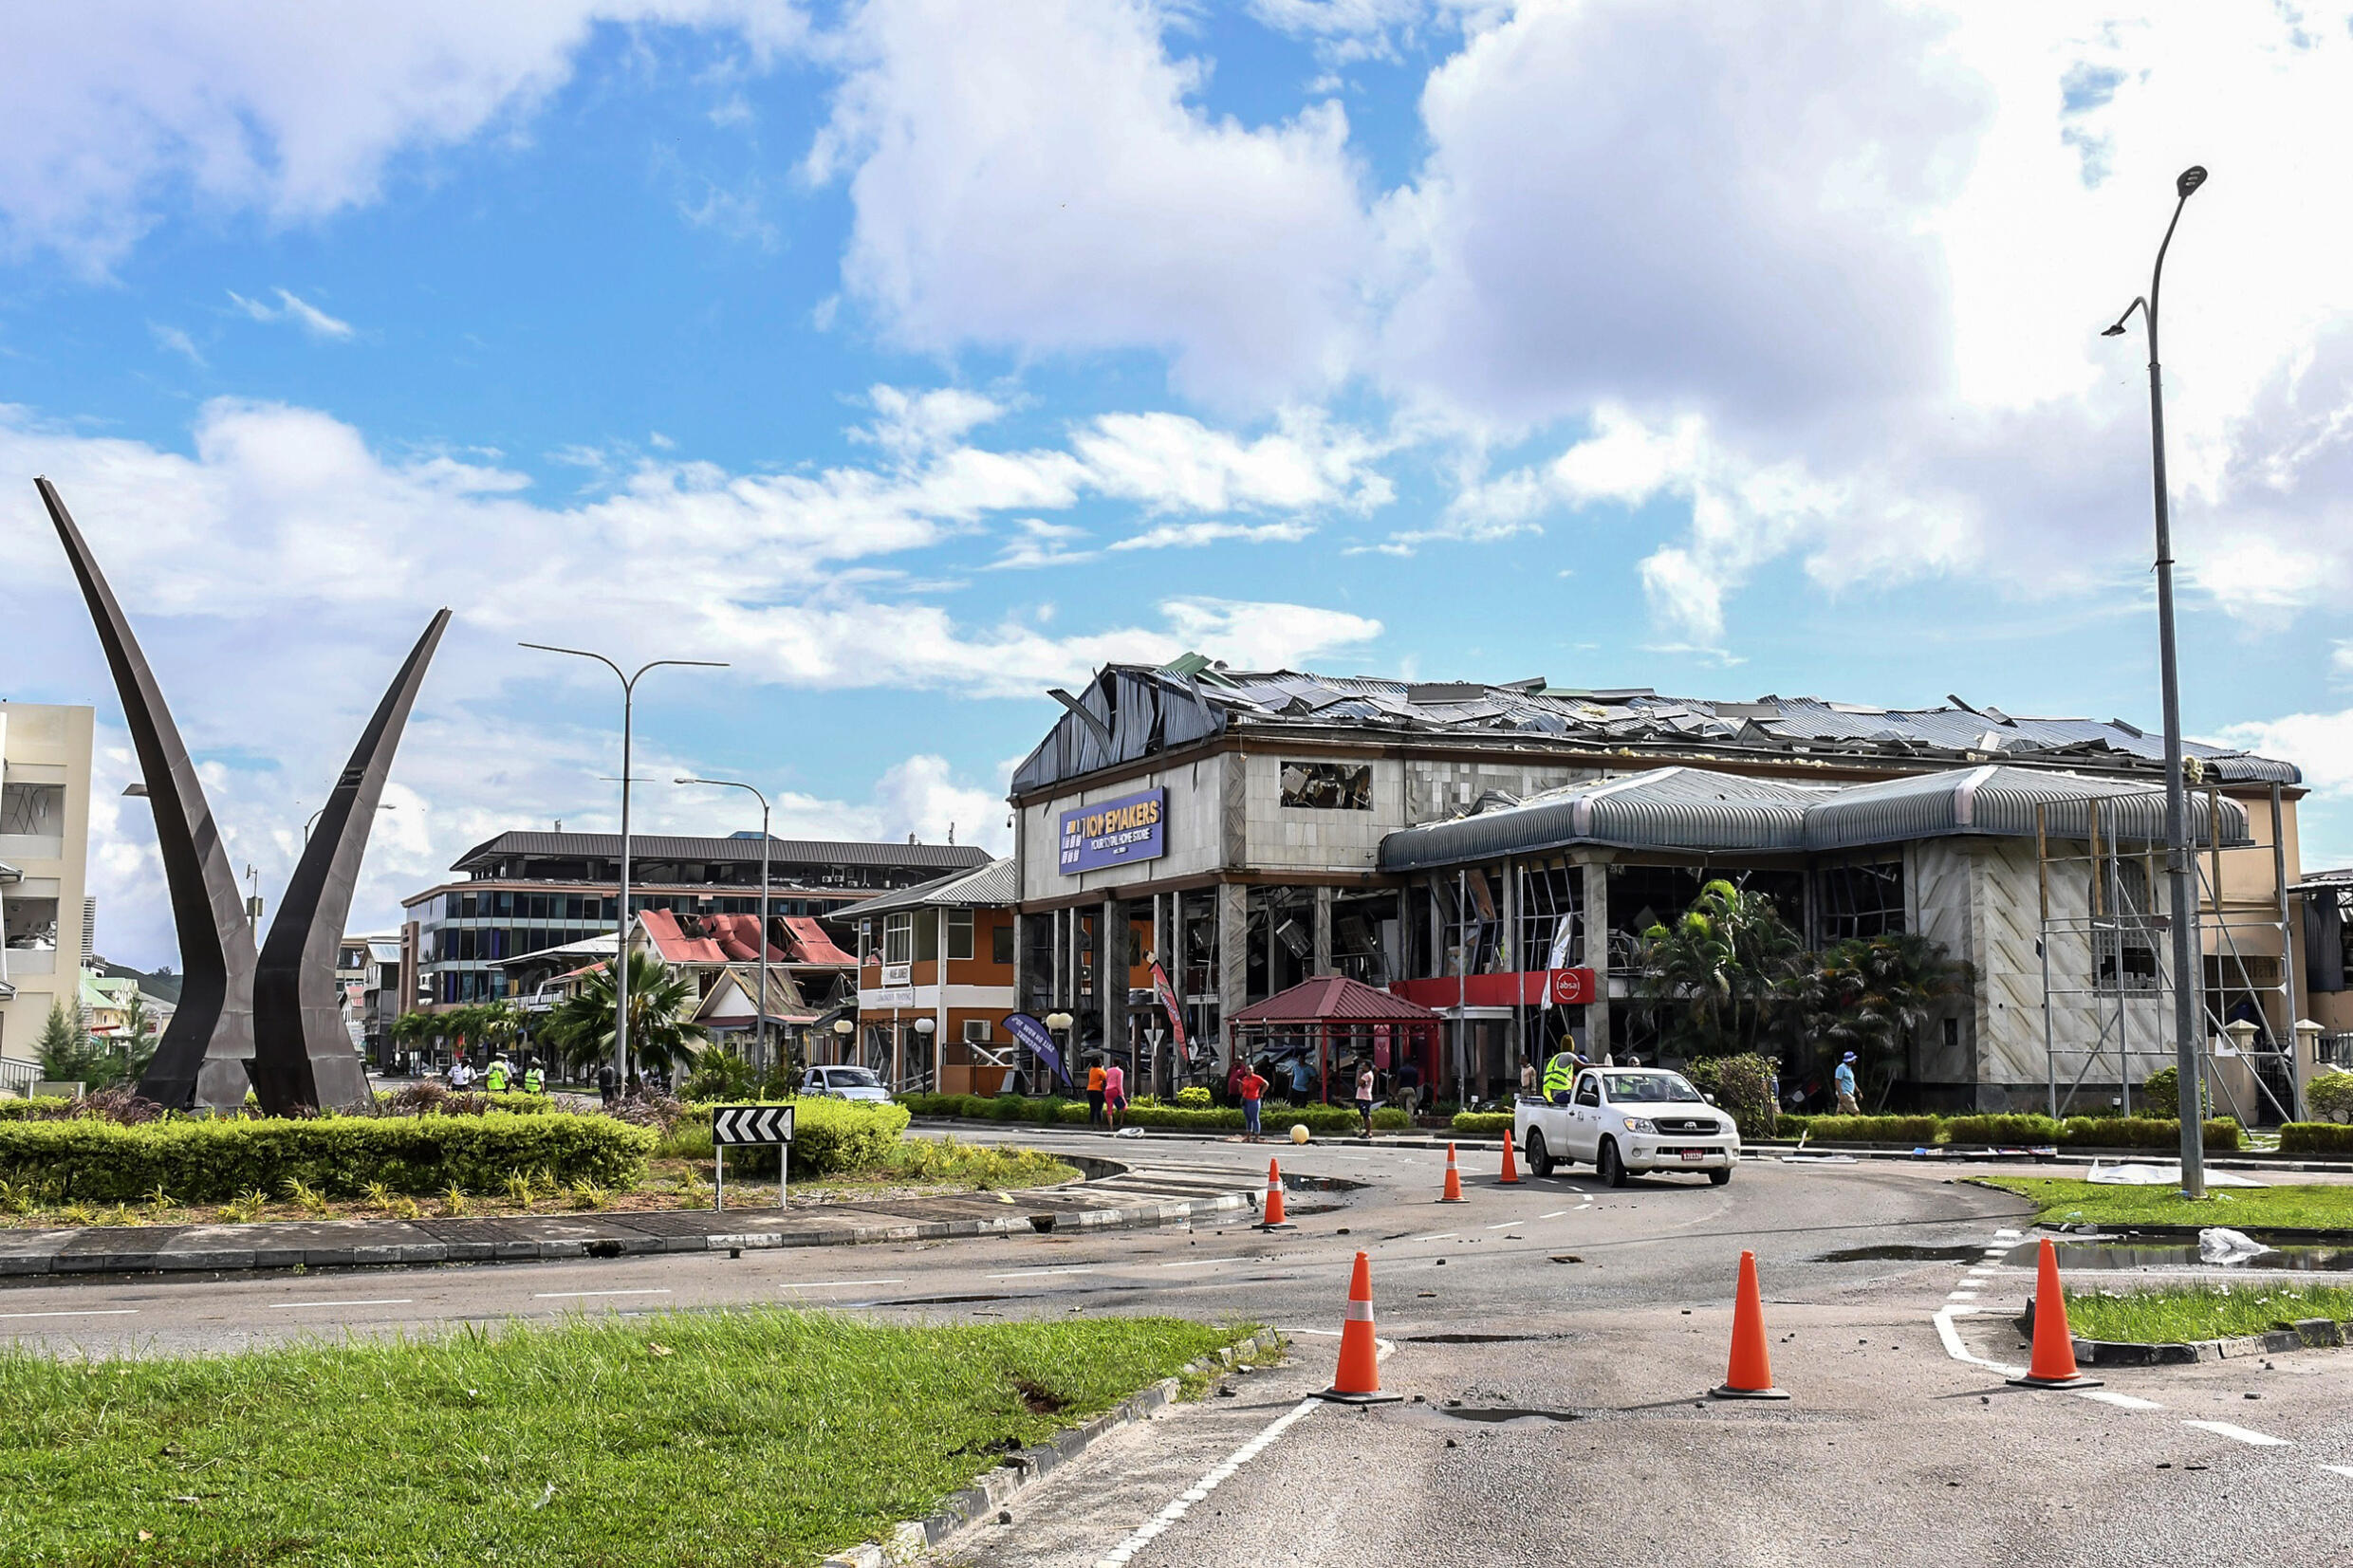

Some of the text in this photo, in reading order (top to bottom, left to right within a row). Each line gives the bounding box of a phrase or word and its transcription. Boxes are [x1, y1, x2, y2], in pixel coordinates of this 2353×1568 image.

[1091, 838, 1104, 850] YOUR
[1132, 827, 1150, 842] STORE
[1560, 981, 1577, 989] absa
